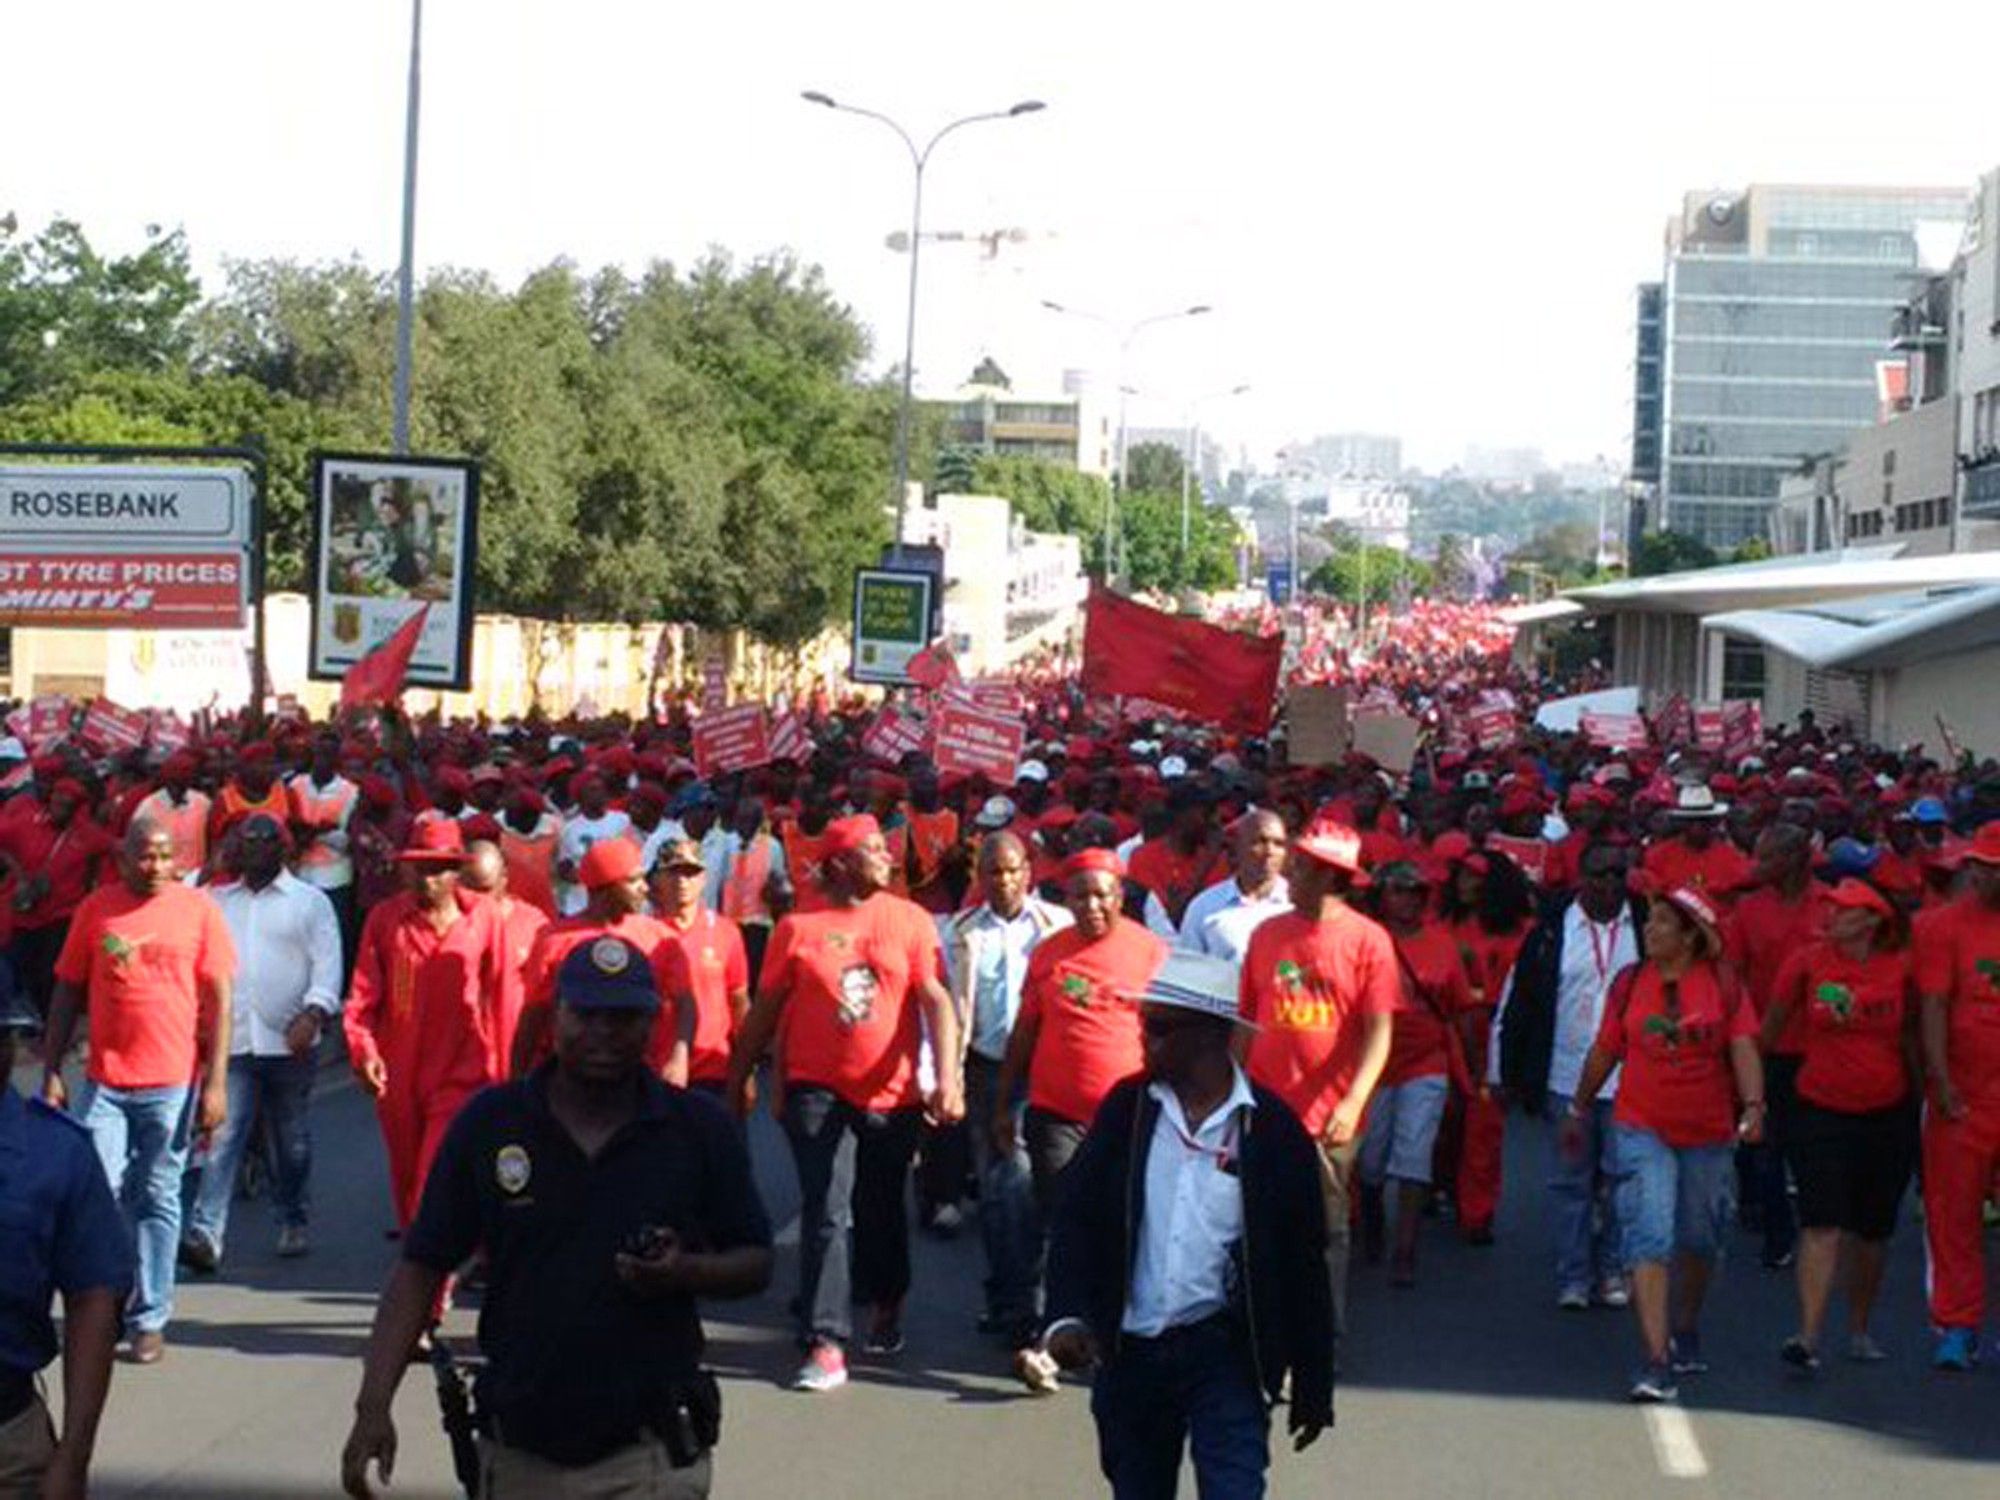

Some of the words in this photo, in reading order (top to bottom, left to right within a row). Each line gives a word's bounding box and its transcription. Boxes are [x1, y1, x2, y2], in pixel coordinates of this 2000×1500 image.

[11, 492, 180, 518] ROSEBANK
[39, 561, 114, 583] TYRE
[122, 562, 238, 584] PRICES
